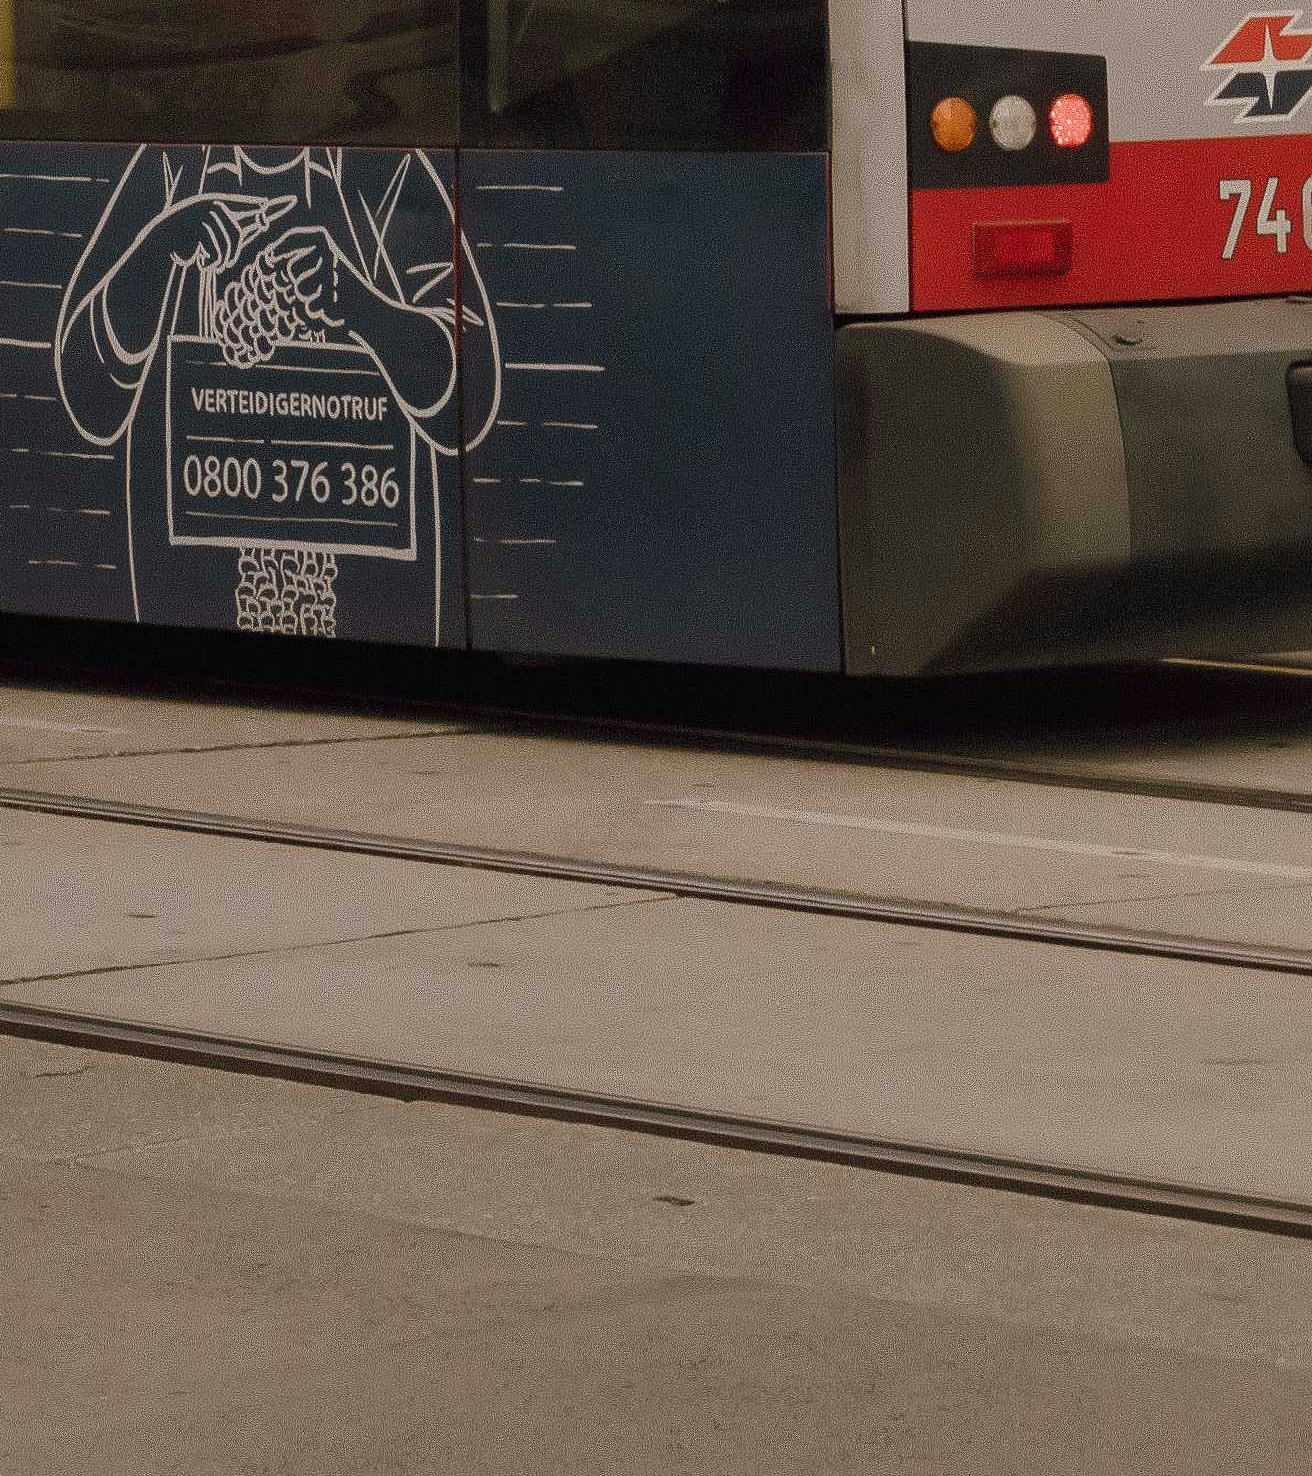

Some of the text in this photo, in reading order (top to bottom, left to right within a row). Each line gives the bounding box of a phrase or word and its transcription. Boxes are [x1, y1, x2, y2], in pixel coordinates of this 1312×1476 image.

[191, 387, 388, 420] VERTEIDIGERNOTRUF
[183, 455, 400, 508] 0800 376 386
